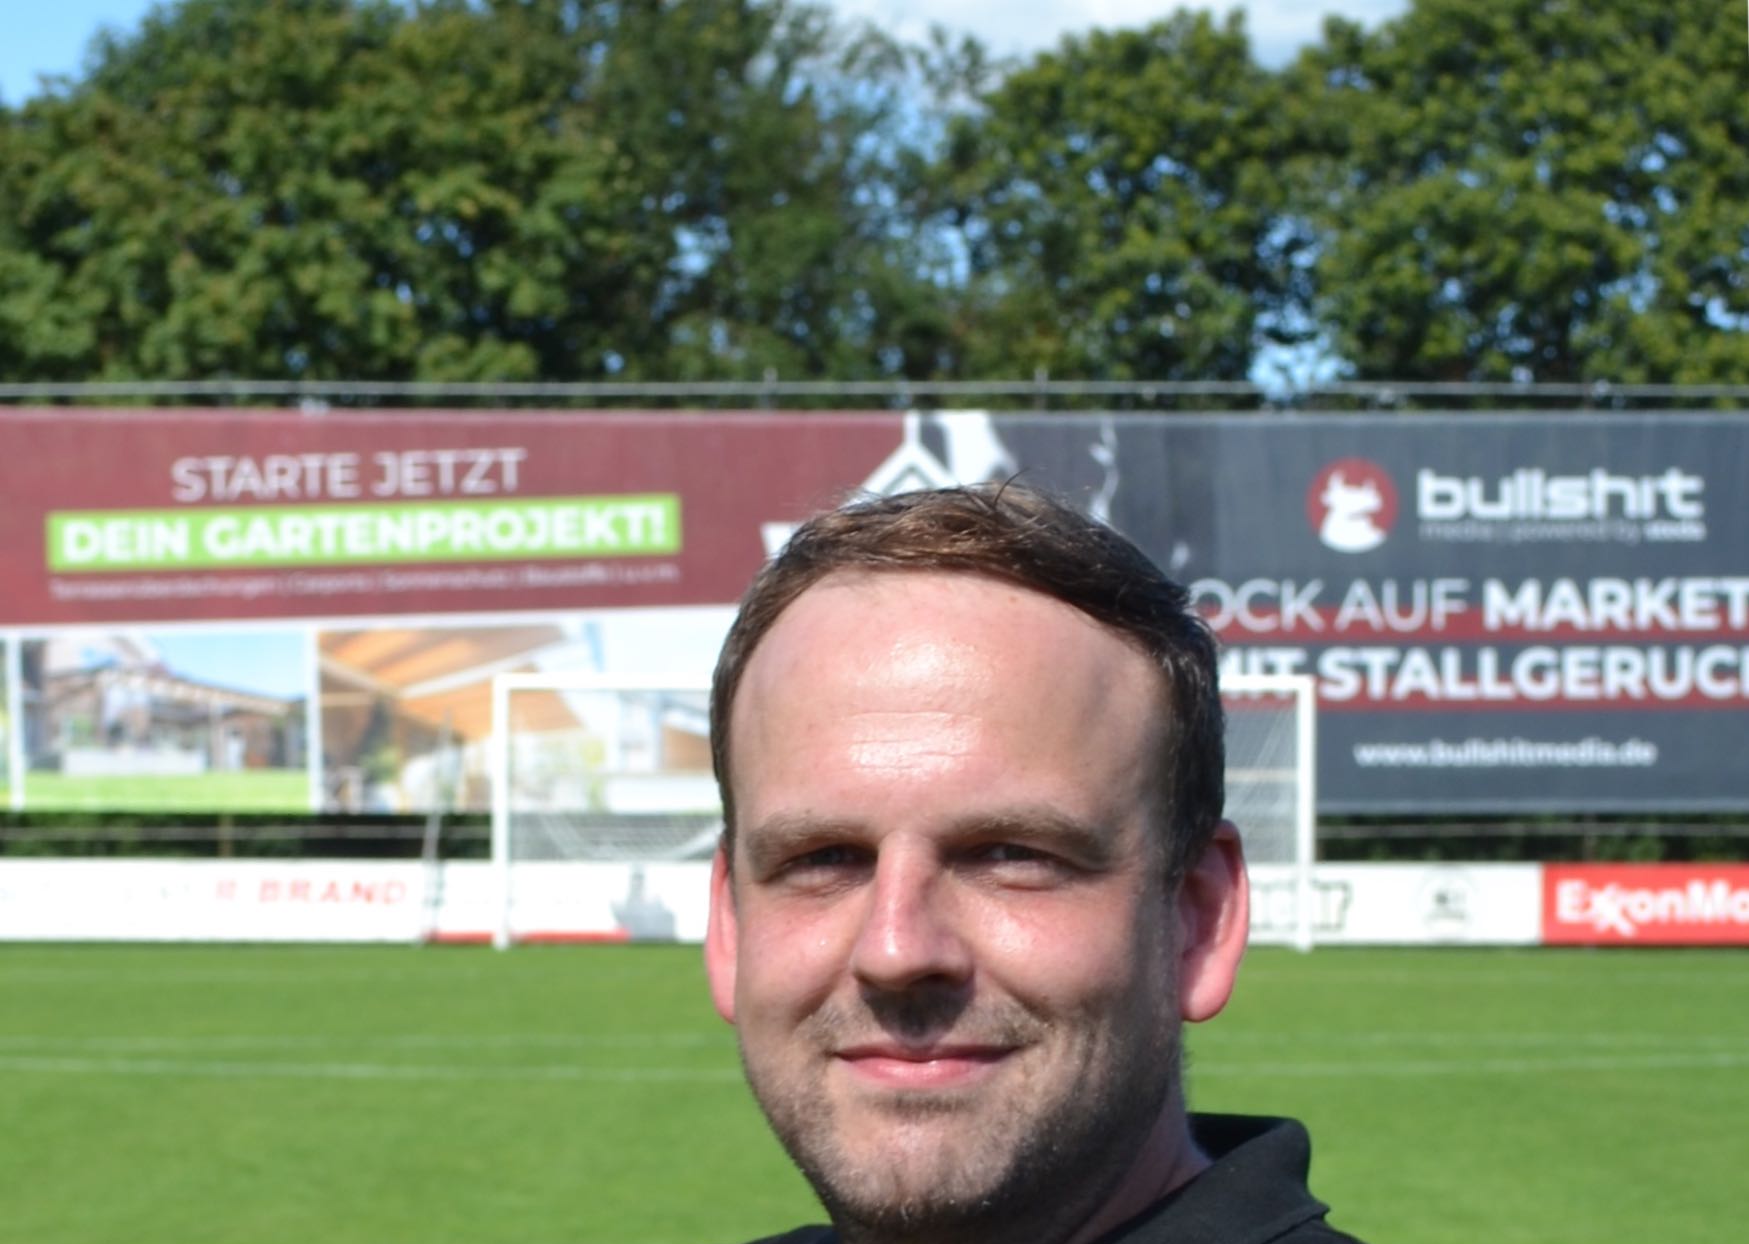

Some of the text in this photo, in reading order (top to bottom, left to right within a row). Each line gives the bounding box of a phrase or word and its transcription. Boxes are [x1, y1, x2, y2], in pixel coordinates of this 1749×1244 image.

[172, 446, 528, 502] STARTE JETZT
[1417, 467, 1704, 520] bullshit
[61, 503, 667, 564] DEIN GARTENPROJEKT!
[1190, 576, 1749, 632] OCK AUF MARKET
